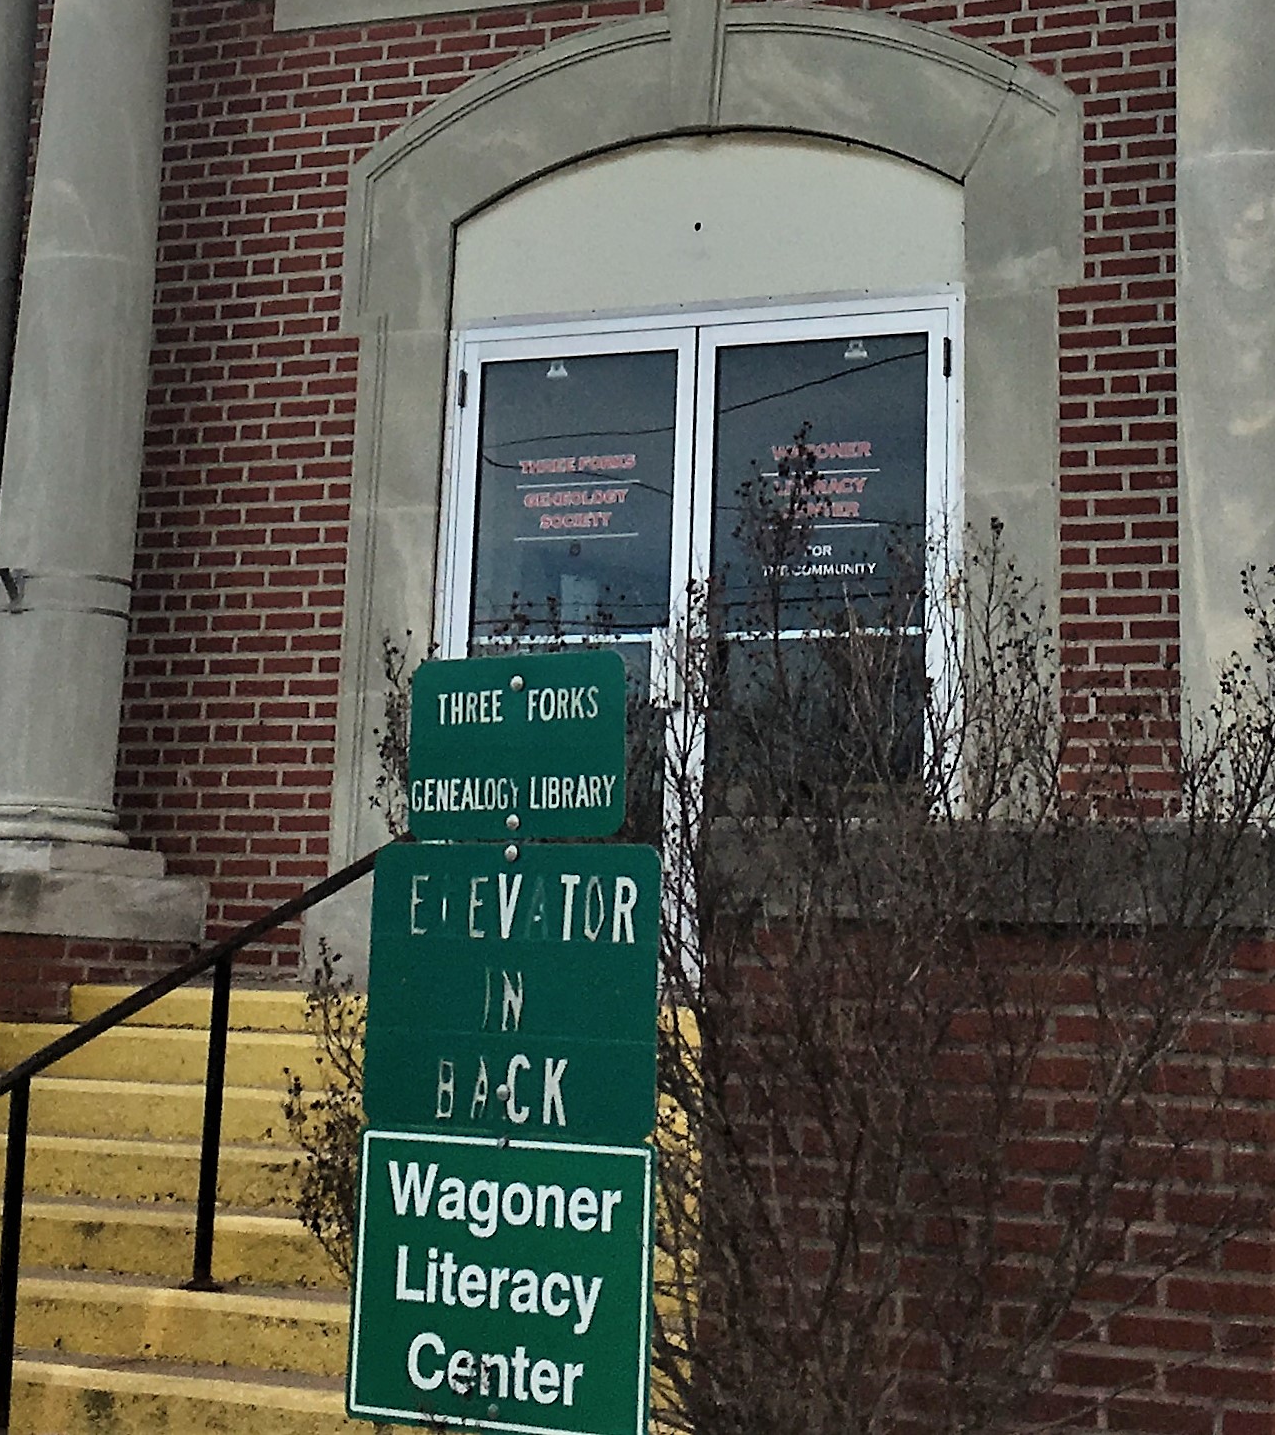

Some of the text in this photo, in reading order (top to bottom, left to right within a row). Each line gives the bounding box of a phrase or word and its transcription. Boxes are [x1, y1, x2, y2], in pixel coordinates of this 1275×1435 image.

[539, 511, 613, 530] SOCIETY
[437, 685, 600, 726] THREE FORKS
[410, 773, 617, 813] GENEALOGY LIBRARY
[410, 872, 639, 945] EEVATOR
[435, 1052, 570, 1127] BACK
[387, 1159, 623, 1239] Wagoner
[395, 1244, 604, 1336] Literacy
[406, 1331, 585, 1407] Center
